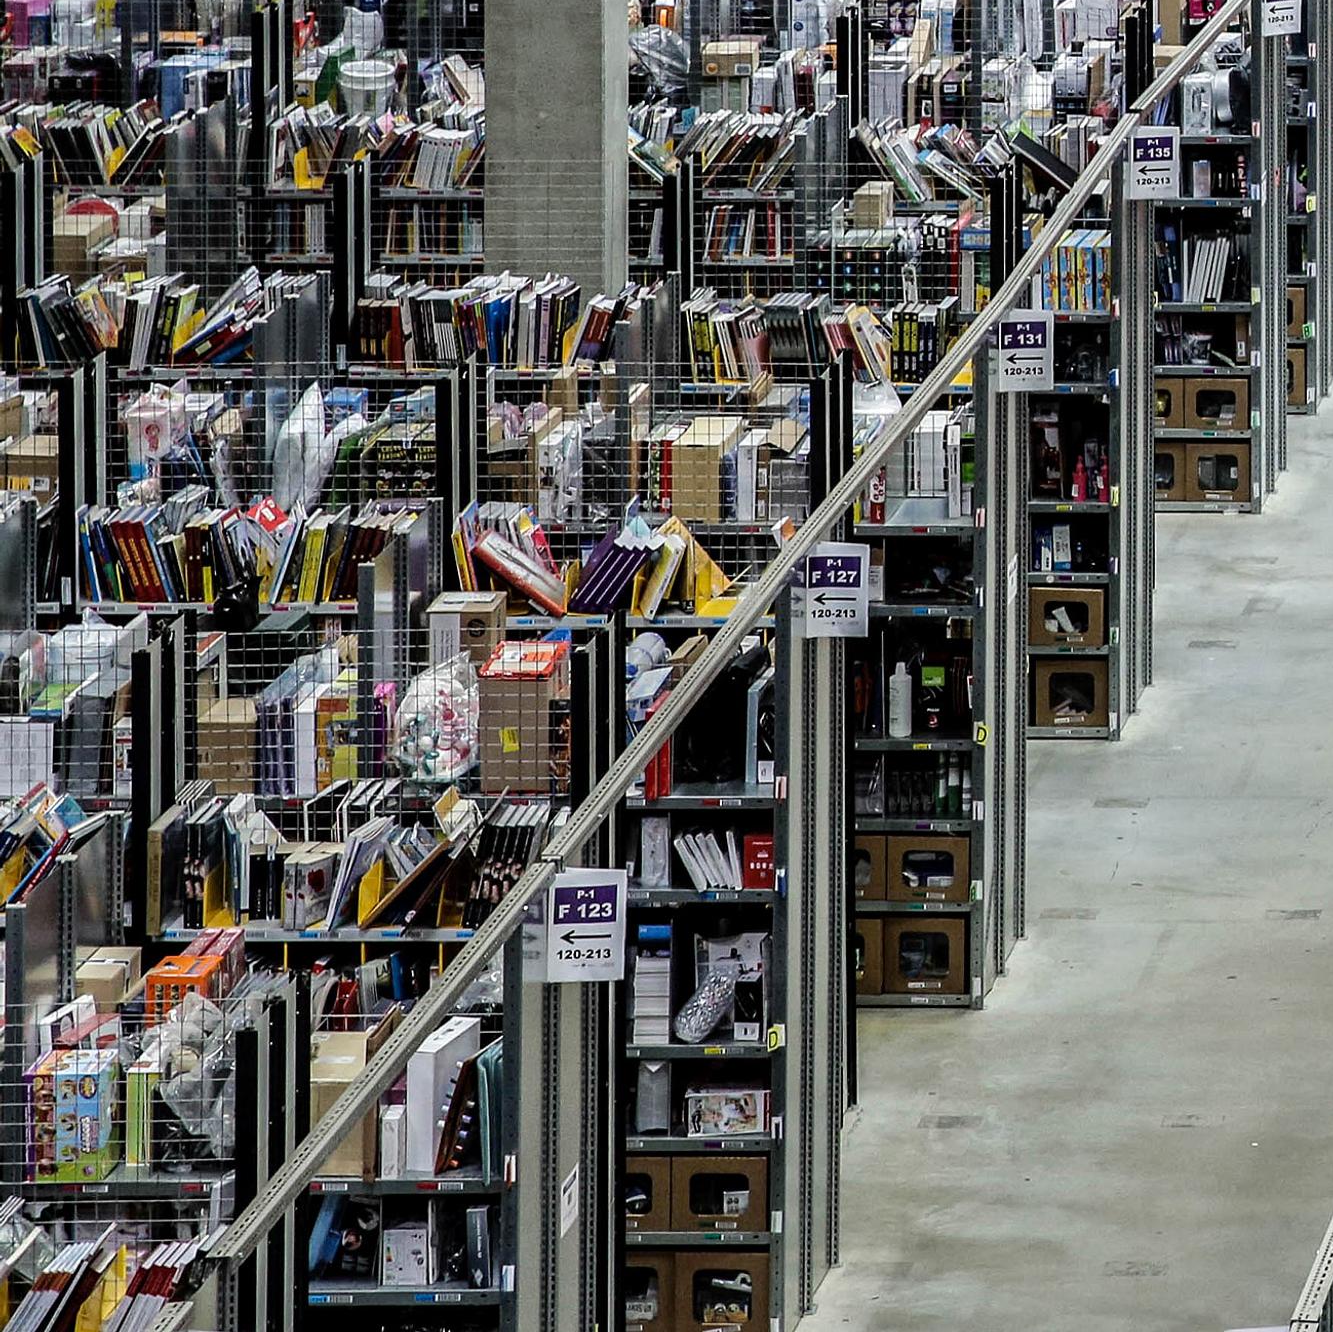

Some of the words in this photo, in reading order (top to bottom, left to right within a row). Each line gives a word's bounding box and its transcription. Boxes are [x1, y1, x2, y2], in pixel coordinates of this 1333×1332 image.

[1267, 14, 1294, 23] 120-213
[1136, 148, 1144, 159] F
[1147, 147, 1171, 158] 135
[1135, 177, 1171, 186] 120-213
[1016, 323, 1030, 331] P-1
[1003, 334, 1012, 346] F
[1017, 334, 1043, 345] 131
[1003, 367, 1044, 376] 120-213
[826, 558, 842, 567] P-1
[811, 571, 822, 584] F
[826, 570, 858, 584] 127
[810, 609, 857, 619] 120-213
[977, 727, 987, 743] D
[576, 889, 595, 899] P-1
[558, 904, 570, 919] F
[577, 902, 613, 919] 123
[556, 947, 612, 960] 120-213
[769, 1031, 778, 1049] D
